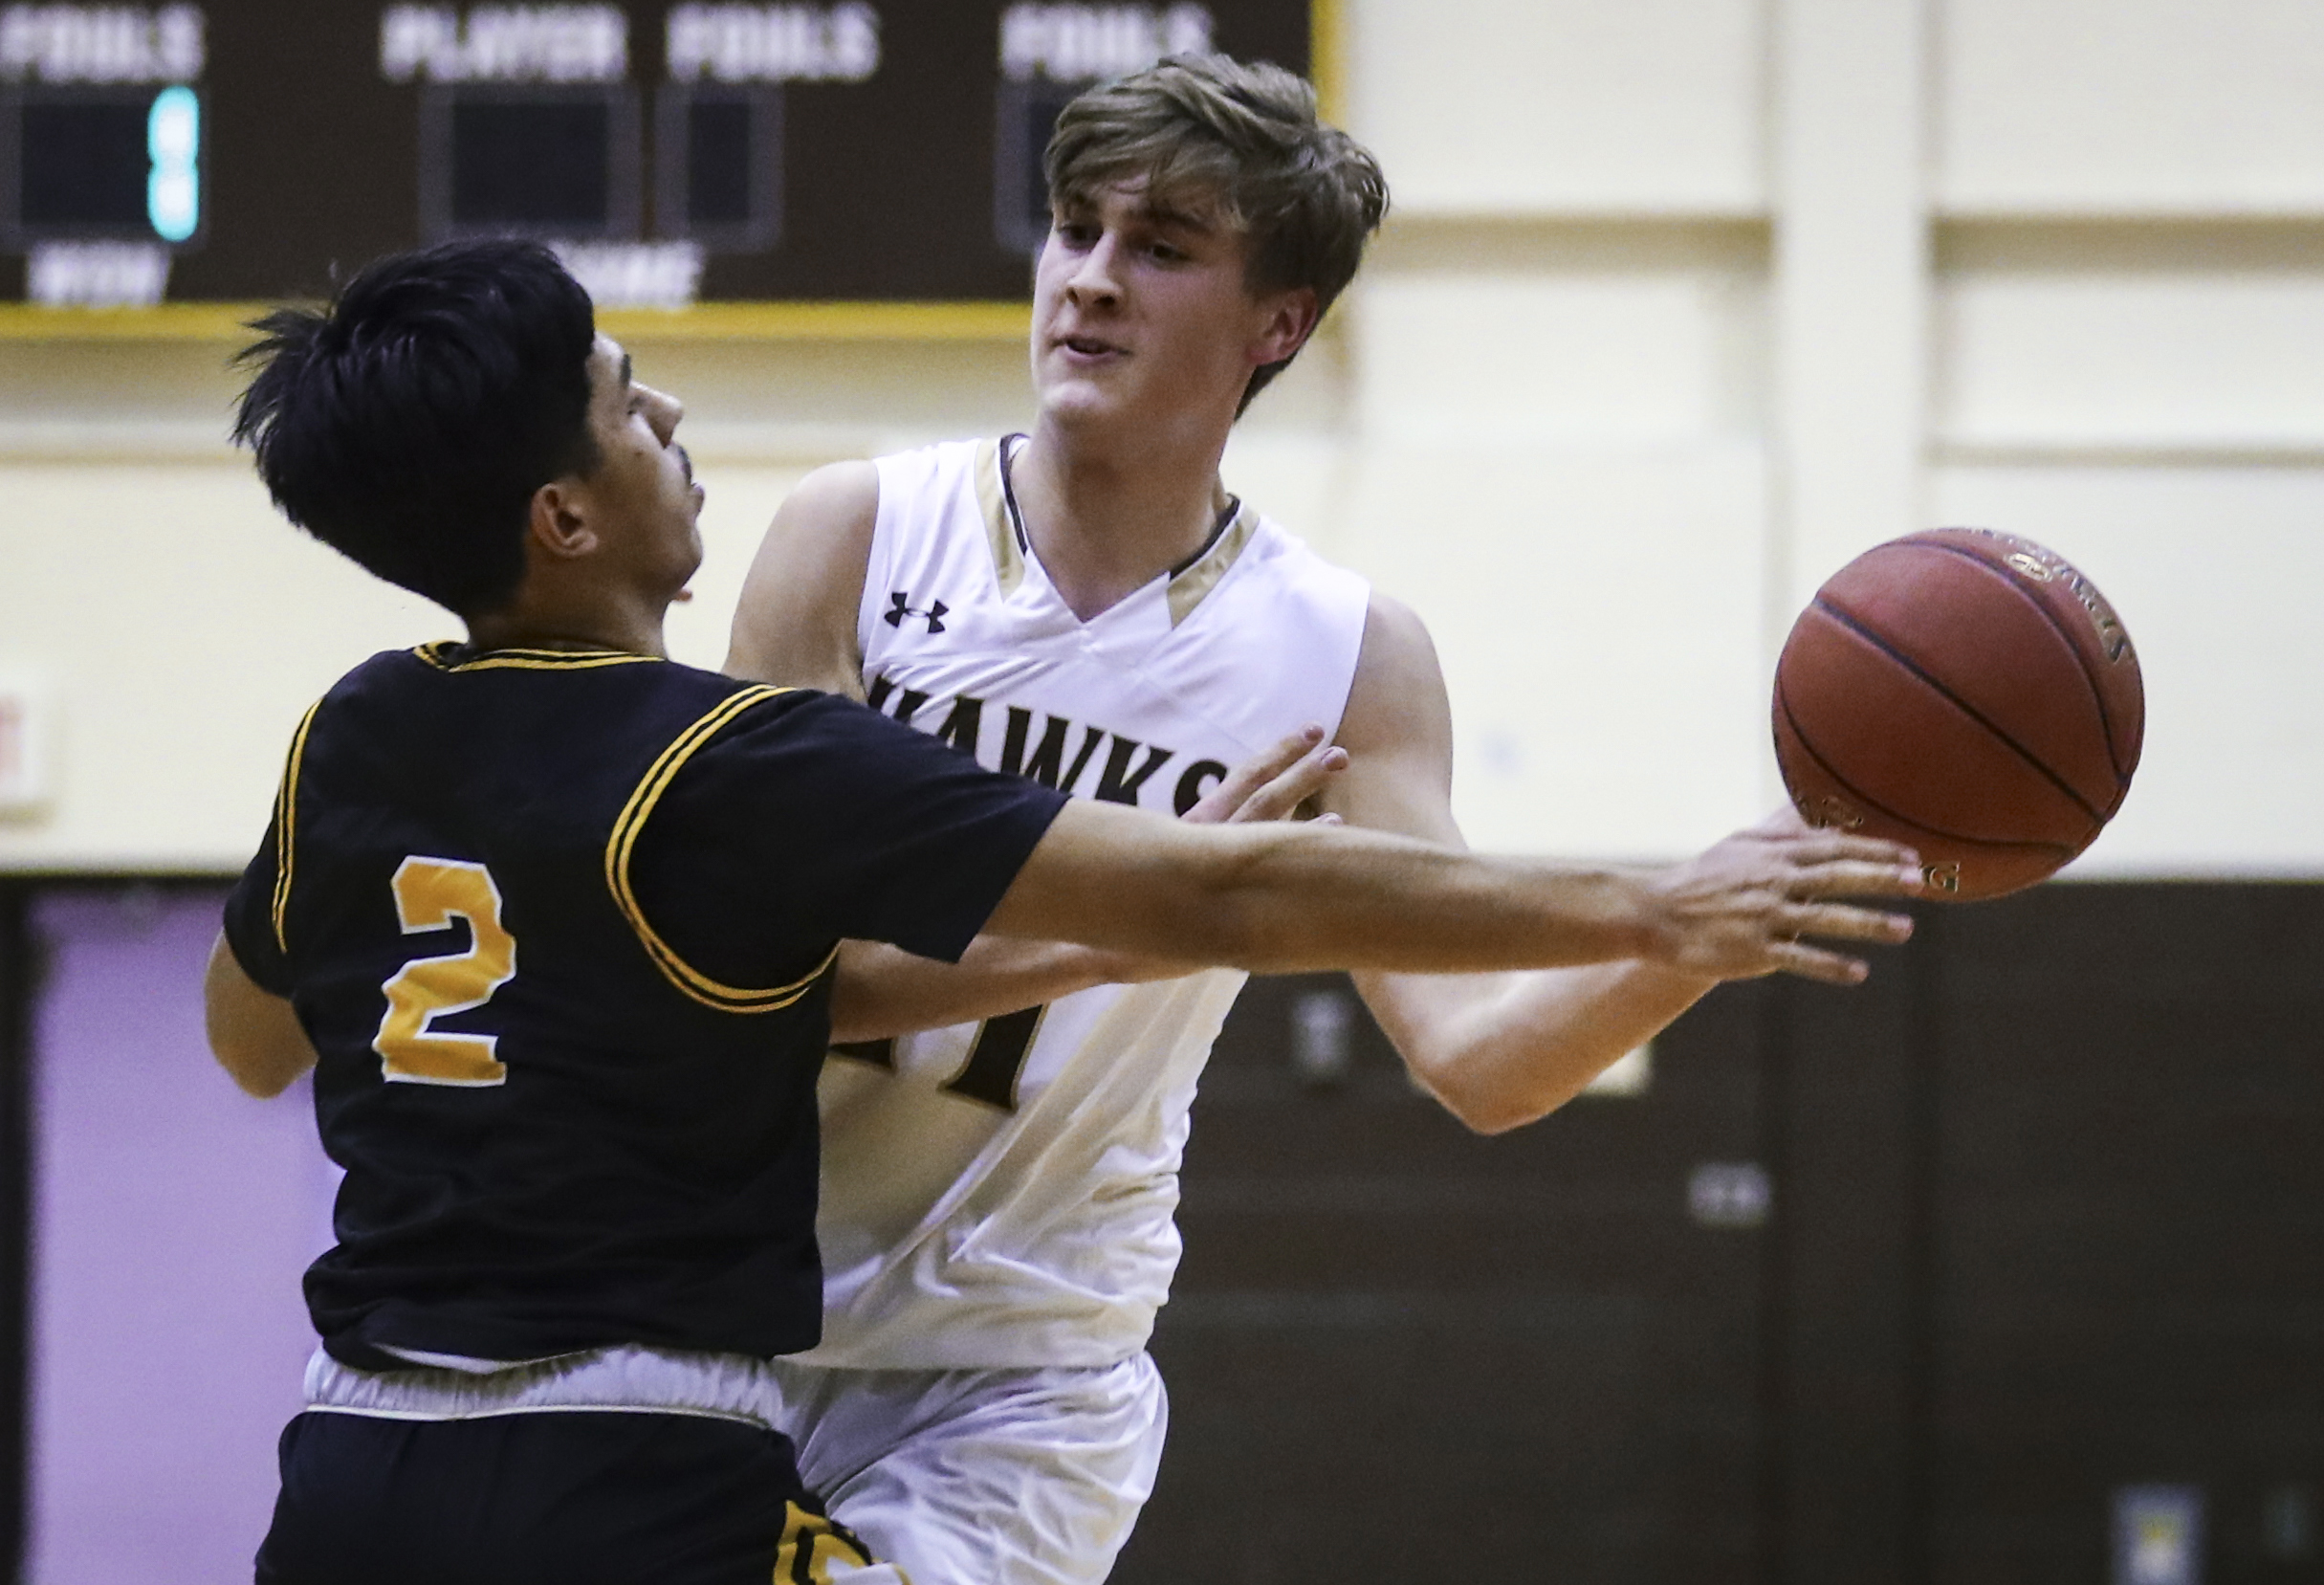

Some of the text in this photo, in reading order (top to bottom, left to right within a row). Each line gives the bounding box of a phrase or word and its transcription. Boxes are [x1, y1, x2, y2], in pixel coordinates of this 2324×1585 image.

[381, 5, 878, 82] PLAYER FOULS
[372, 854, 517, 1087] 2
